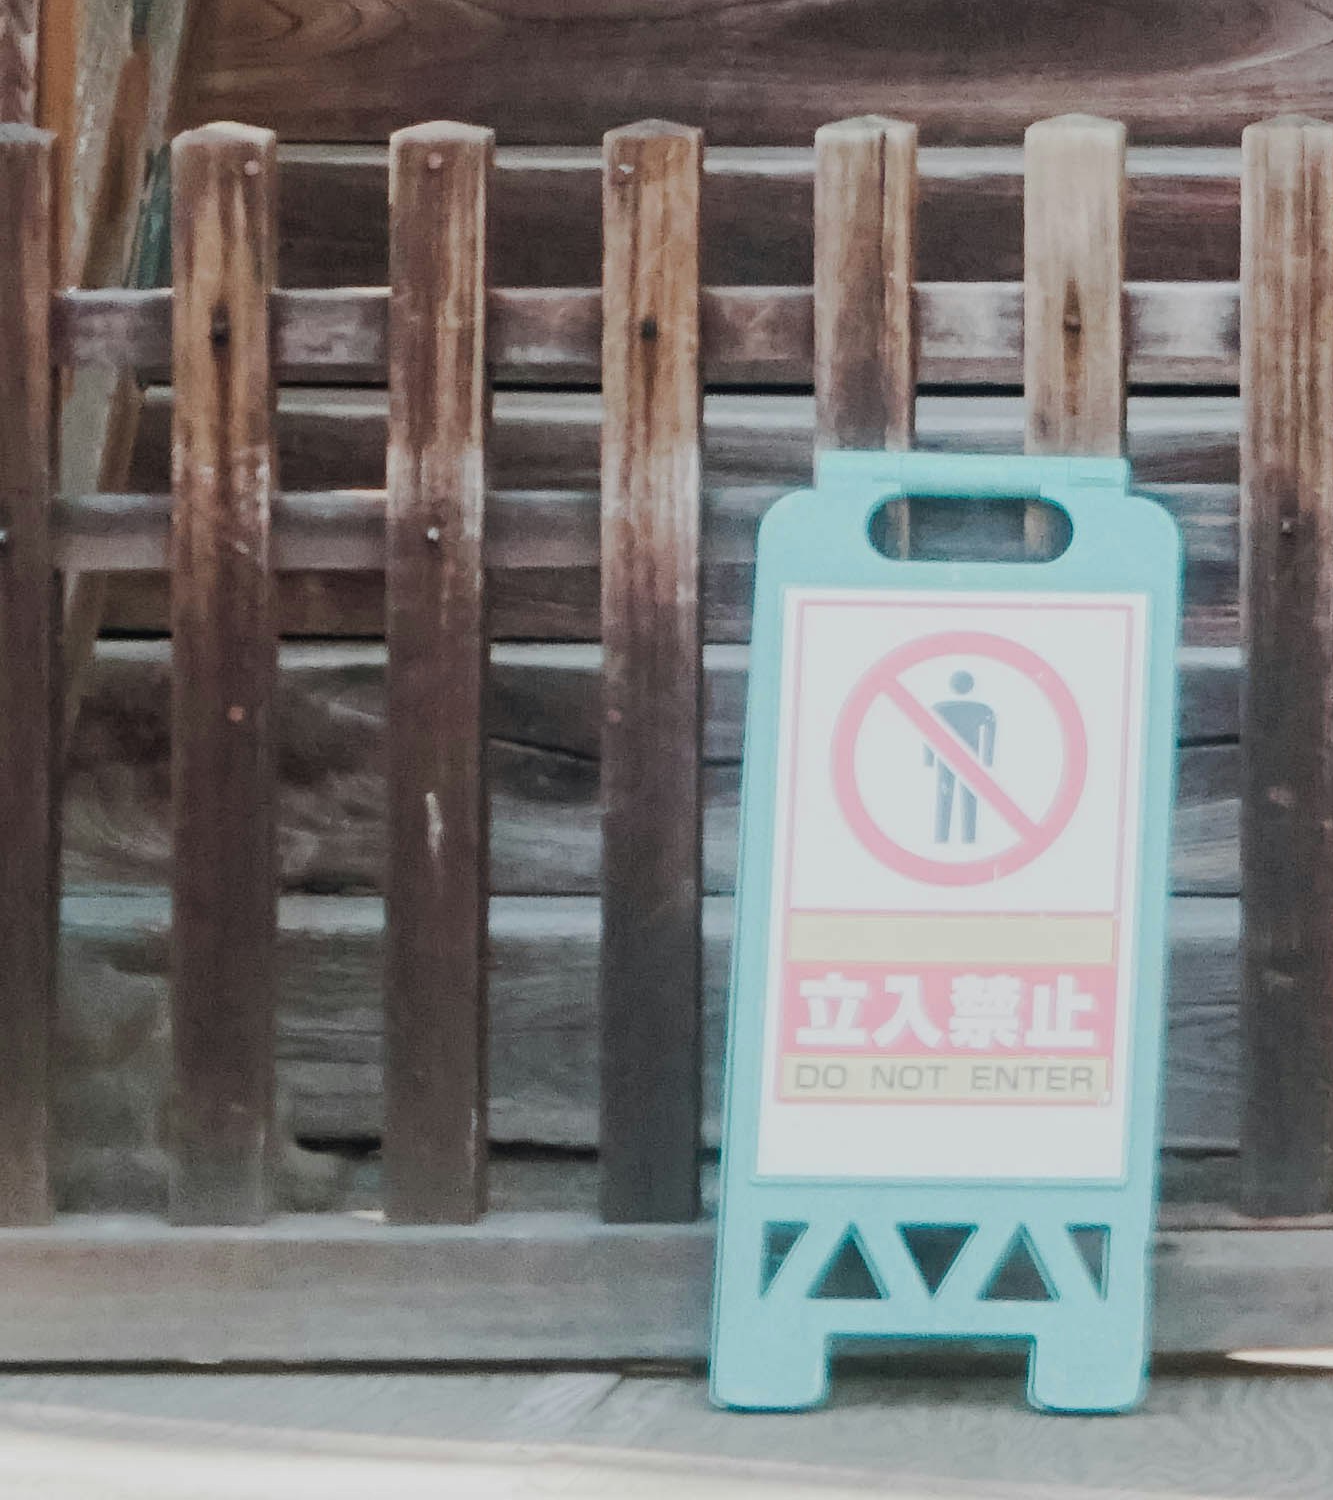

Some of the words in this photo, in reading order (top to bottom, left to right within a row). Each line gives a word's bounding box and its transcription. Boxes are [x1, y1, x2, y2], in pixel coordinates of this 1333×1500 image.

[795, 971, 1096, 1049] 立入禁止
[795, 1064, 847, 1090] DO
[871, 1064, 948, 1091] NOT
[970, 1065, 1094, 1092] ENTER
